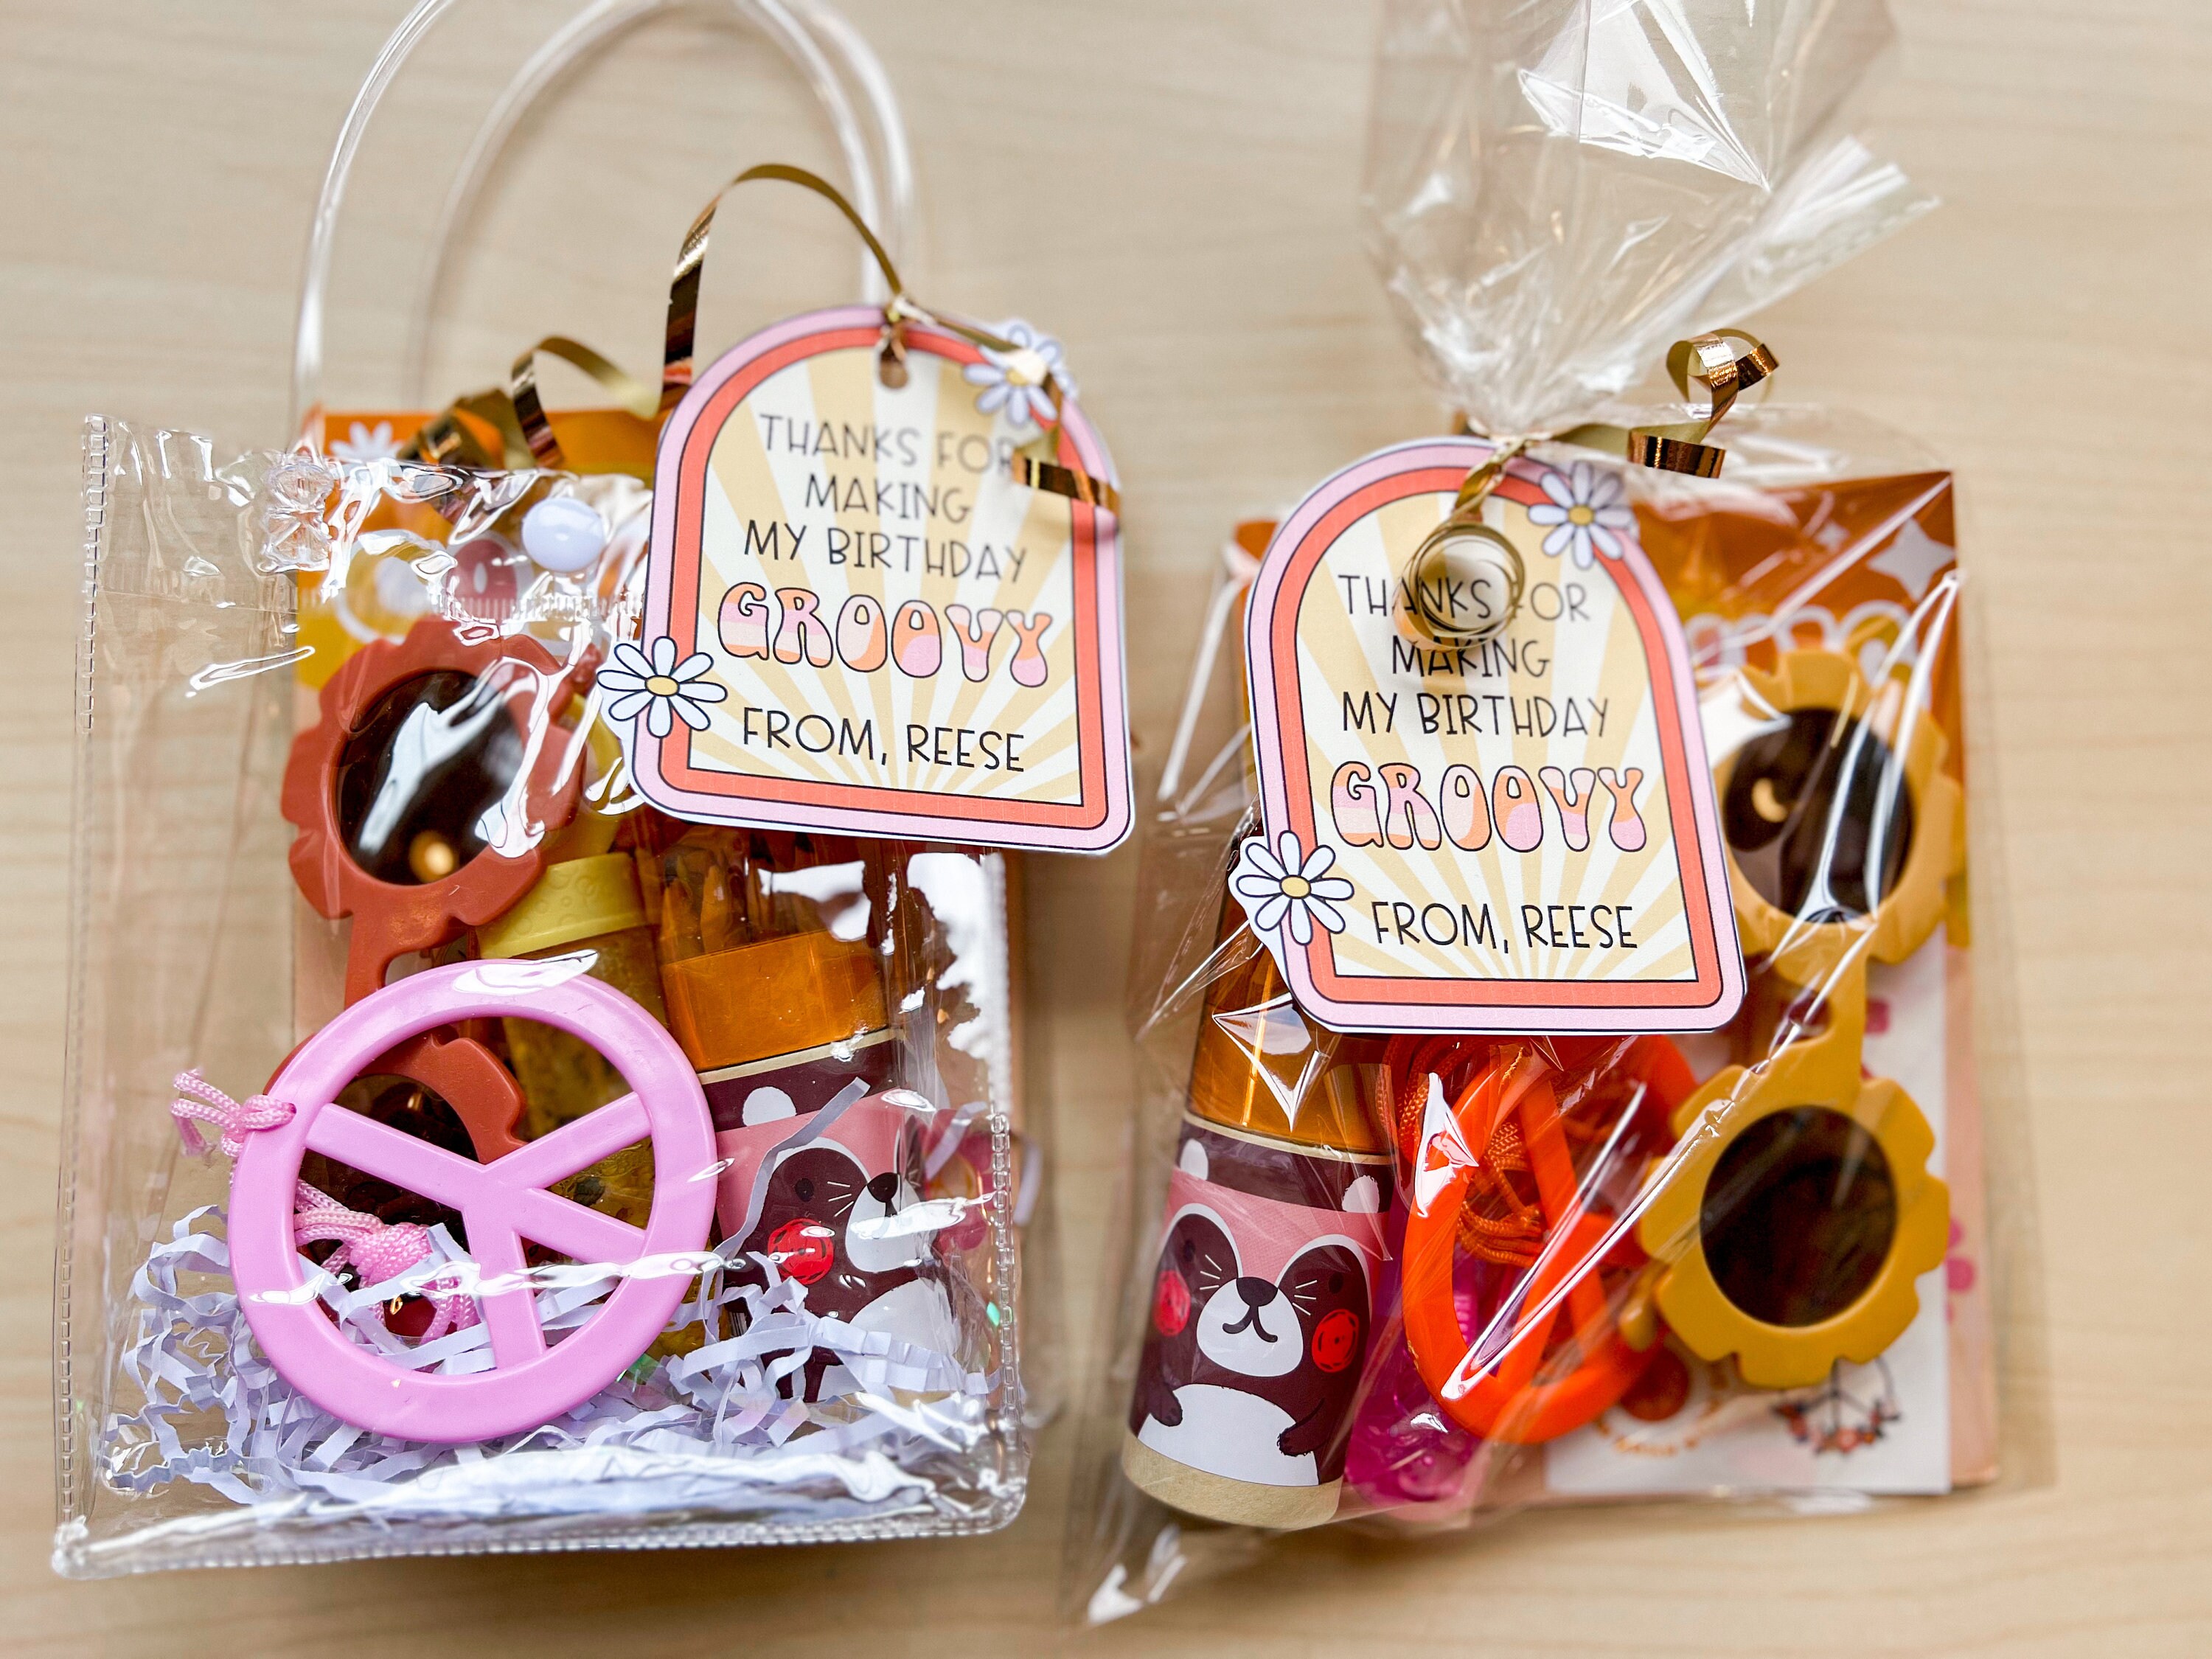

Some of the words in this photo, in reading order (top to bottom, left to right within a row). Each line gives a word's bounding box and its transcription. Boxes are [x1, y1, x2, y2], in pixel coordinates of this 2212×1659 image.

[759, 414, 922, 467] THANKS
[804, 474, 970, 524] MAKING
[744, 521, 807, 561] MY
[828, 527, 1027, 583] BIRTHDAY
[717, 582, 1053, 688] GROOVY
[1392, 635, 1550, 678] MAKING
[743, 707, 888, 767] FROM,
[908, 725, 1026, 773] REESE
[1343, 691, 1397, 735] MY
[1419, 692, 1610, 738] BIRTHDAY
[1330, 760, 1647, 853] GROOVY
[1371, 901, 1509, 954] FROM,
[1521, 904, 1638, 950] REESE
